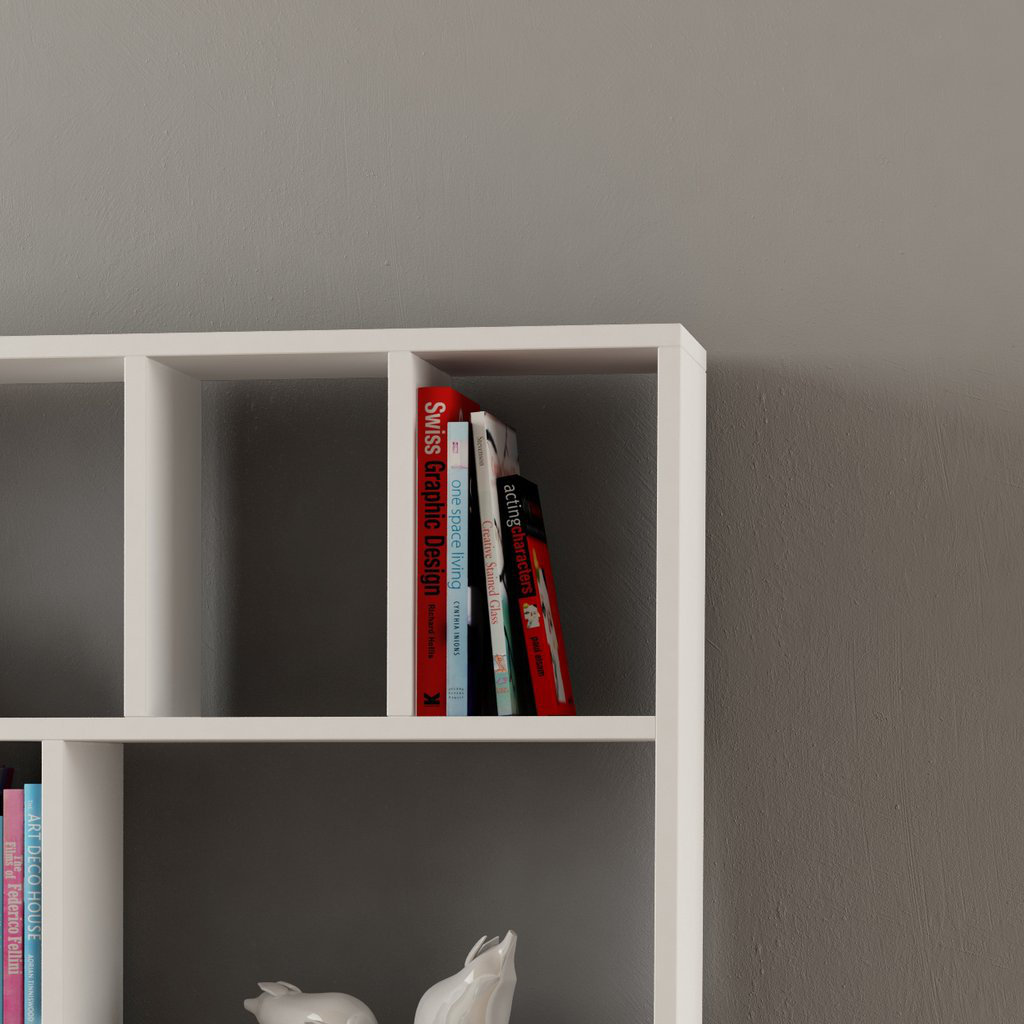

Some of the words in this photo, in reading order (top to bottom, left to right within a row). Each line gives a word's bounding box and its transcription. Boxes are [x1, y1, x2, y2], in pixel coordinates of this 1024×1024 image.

[424, 402, 446, 454] Swiss
[477, 436, 486, 466] Stevenson
[422, 461, 446, 529] Graphic
[451, 480, 462, 505] one
[449, 509, 462, 548] space
[482, 520, 494, 559] Creative
[421, 536, 445, 595] Design
[448, 552, 464, 589] living
[486, 562, 499, 596] Stained
[428, 604, 436, 634] Richard
[490, 600, 500, 625] Glass
[27, 813, 40, 840] ART
[5, 841, 15, 866] Films
[14, 855, 22, 872] The
[27, 846, 40, 886] DECO
[5, 870, 16, 879] of
[7, 884, 22, 933] Federico
[27, 891, 40, 940] HOUSE
[8, 936, 22, 974] Fellini
